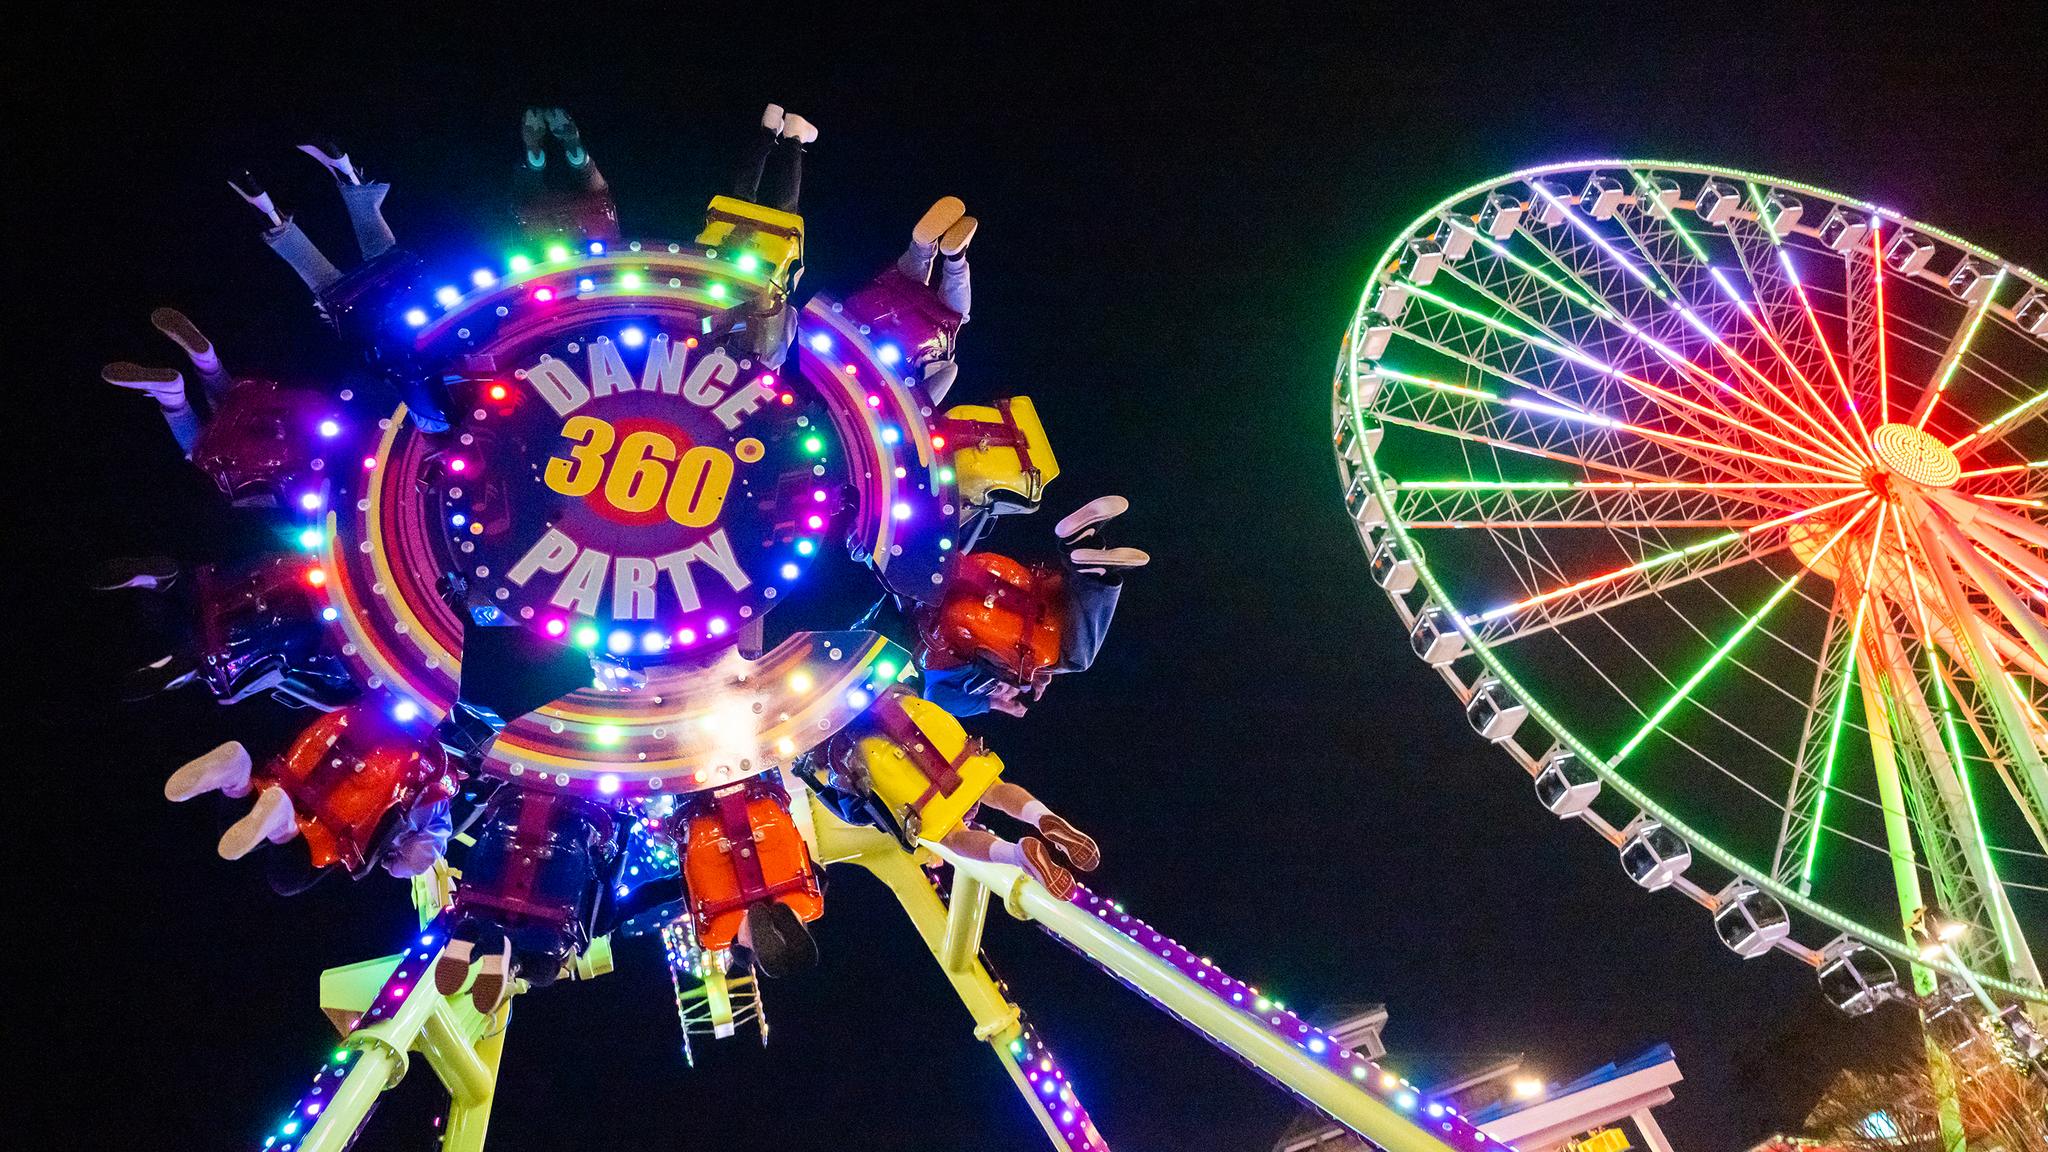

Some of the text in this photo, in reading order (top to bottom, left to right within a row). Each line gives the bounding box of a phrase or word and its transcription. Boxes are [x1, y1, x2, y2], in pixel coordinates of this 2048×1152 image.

[525, 341, 777, 430] DANCE
[544, 416, 765, 527] 360°
[507, 529, 751, 619] PARTY
